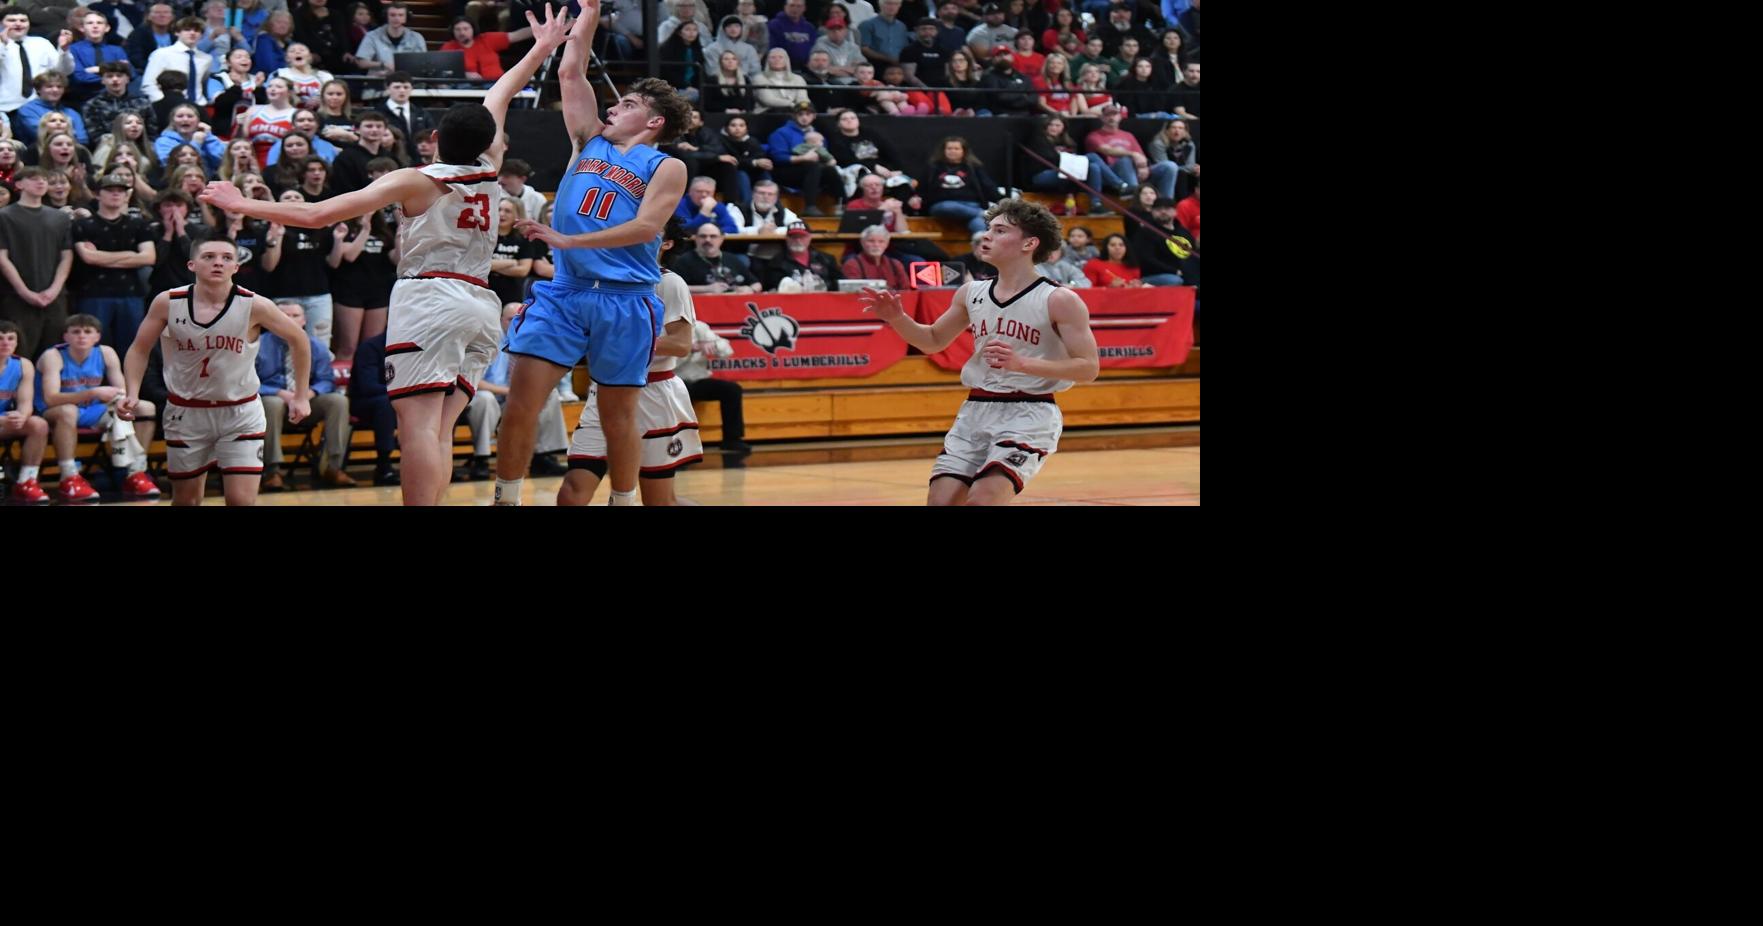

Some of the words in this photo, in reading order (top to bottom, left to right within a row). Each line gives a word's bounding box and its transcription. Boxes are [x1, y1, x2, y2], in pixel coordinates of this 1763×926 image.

[456, 192, 491, 232] 23
[577, 186, 618, 222] 11
[205, 335, 244, 354] LONG
[996, 317, 1042, 347] LONG
[199, 356, 211, 378] 1
